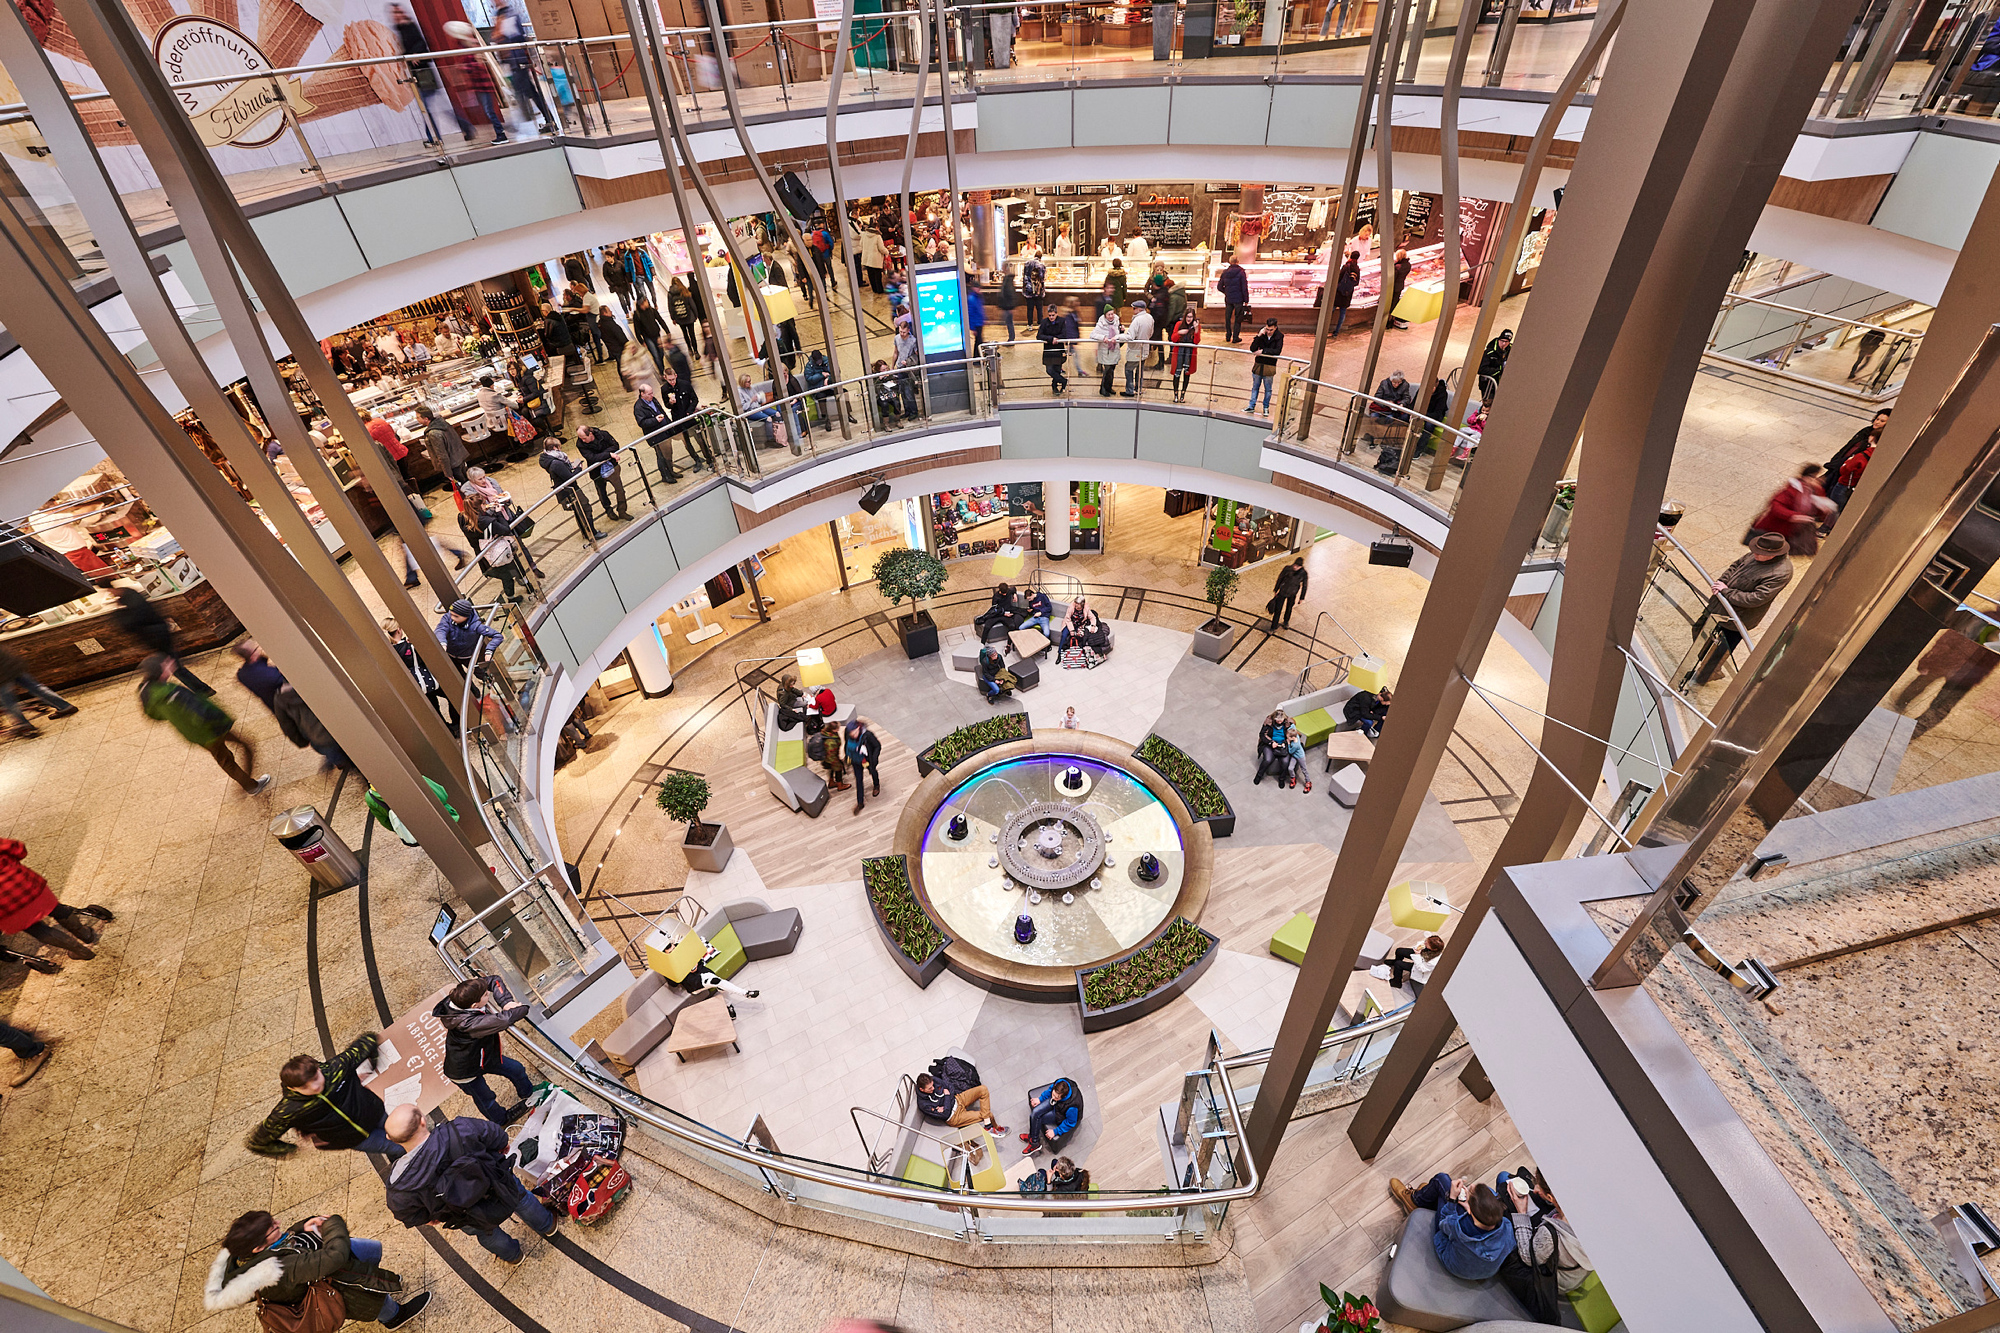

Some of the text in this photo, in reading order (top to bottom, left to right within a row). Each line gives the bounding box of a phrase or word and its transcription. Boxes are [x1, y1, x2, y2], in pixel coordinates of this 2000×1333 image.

[164, 26, 260, 111] Wedereröffnung
[1216, 529, 1231, 538] SALE
[406, 1021, 439, 1063] ABFRAGE
[419, 1010, 447, 1054] GUTHA
[406, 1055, 425, 1072] €?
